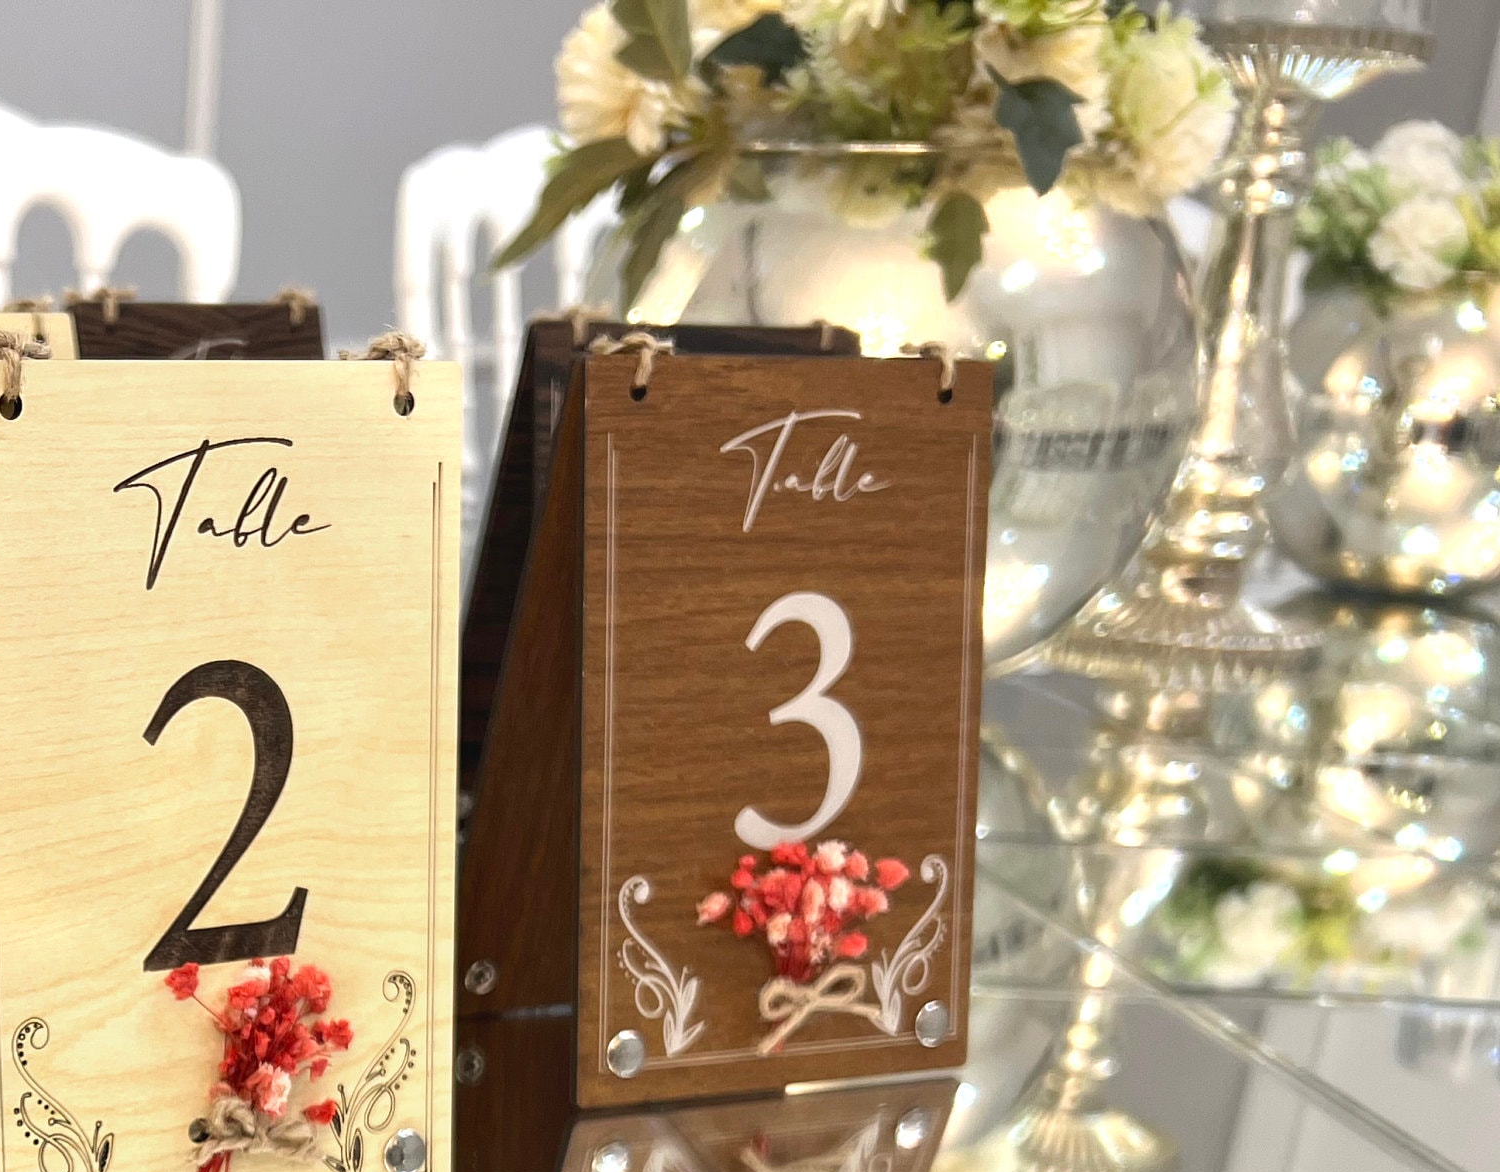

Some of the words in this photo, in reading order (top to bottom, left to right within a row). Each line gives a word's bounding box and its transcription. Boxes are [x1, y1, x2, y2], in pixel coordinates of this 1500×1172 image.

[113, 436, 332, 591] Table
[719, 408, 892, 534] Table
[142, 659, 309, 973] 2
[733, 590, 863, 850] 3
